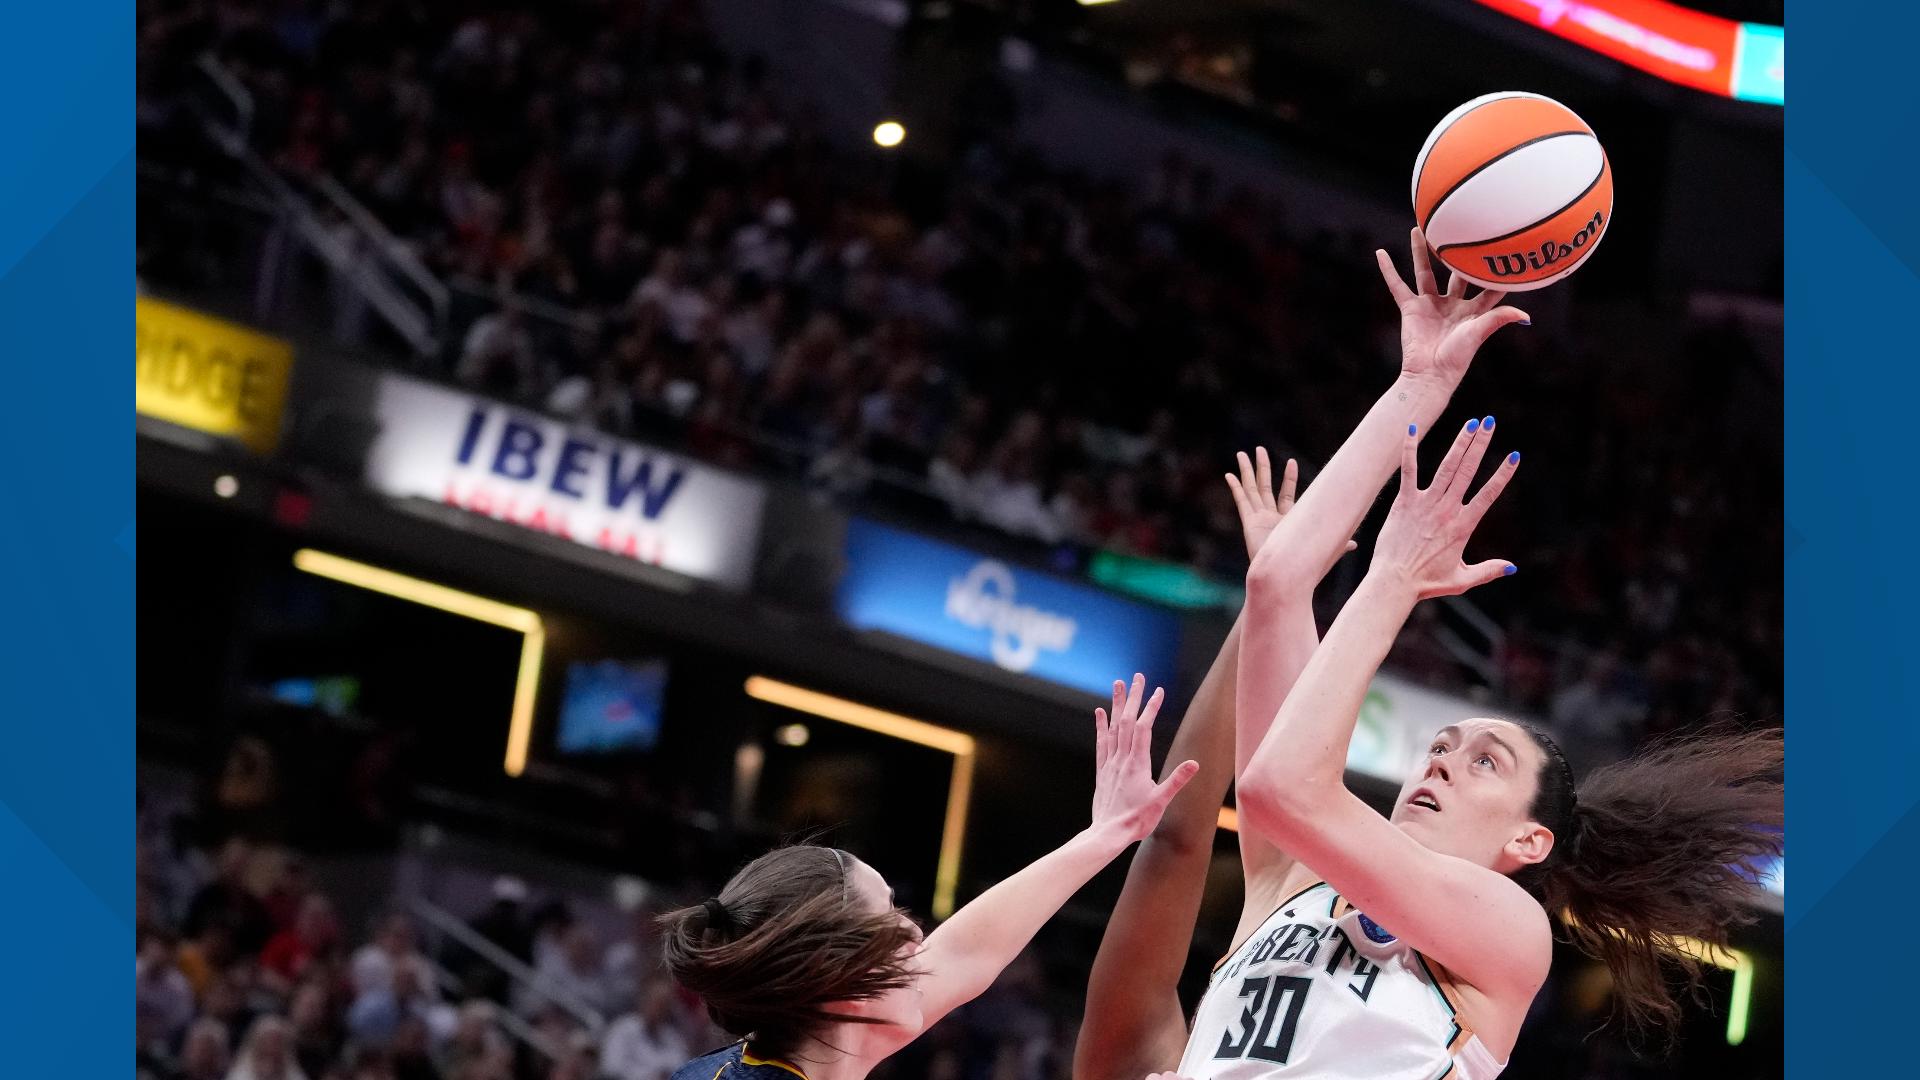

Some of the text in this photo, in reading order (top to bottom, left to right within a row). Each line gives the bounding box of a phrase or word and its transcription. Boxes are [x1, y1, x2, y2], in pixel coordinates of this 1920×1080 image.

[1482, 210, 1603, 277] Wilson
[456, 408, 683, 521] IBEW
[1212, 974, 1314, 1067] 30
